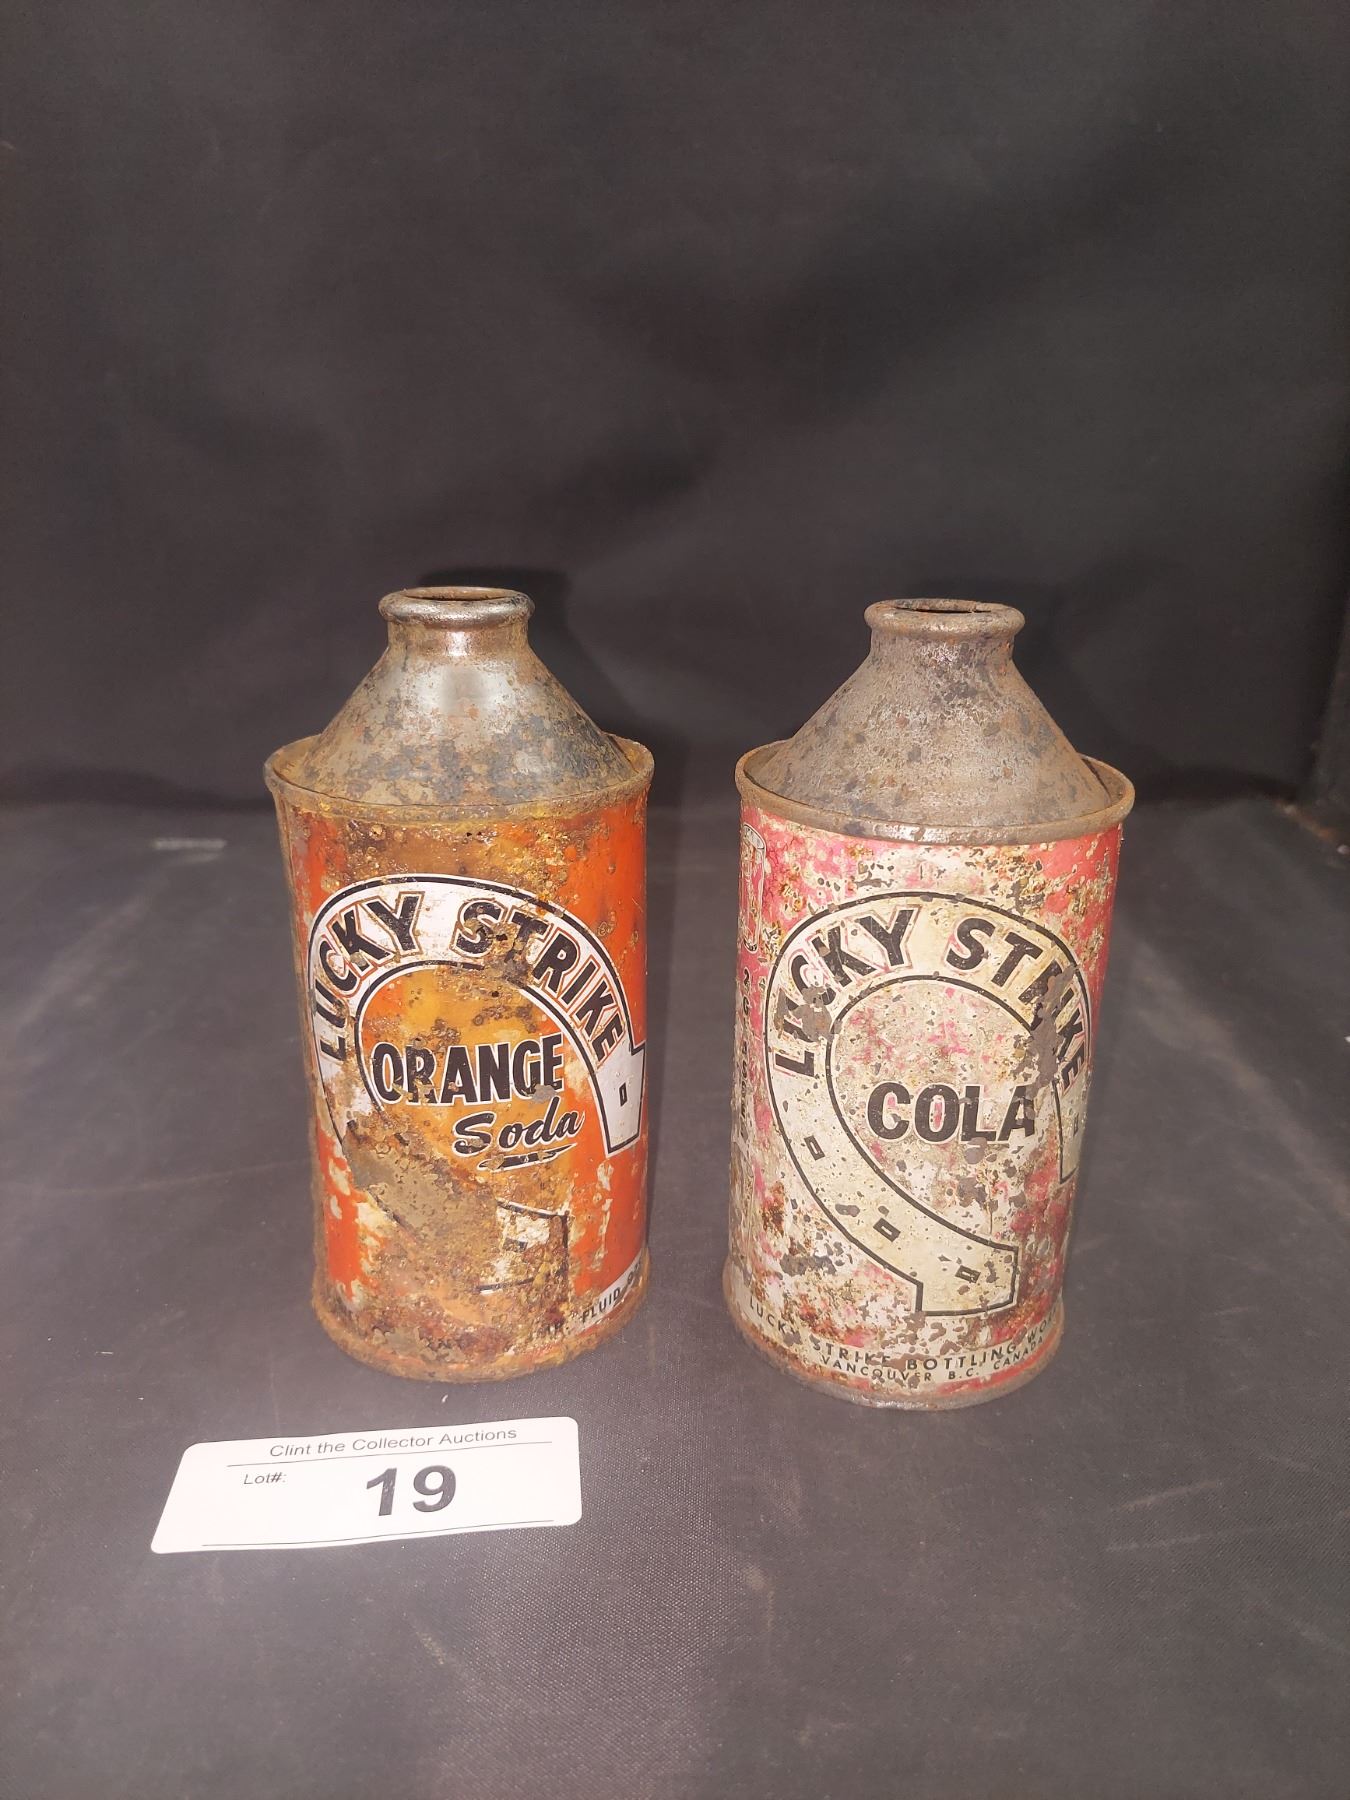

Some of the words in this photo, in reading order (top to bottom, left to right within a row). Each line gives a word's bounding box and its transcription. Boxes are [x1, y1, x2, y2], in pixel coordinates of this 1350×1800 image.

[315, 895, 420, 1062] LUCKY
[456, 900, 624, 1063] STRIKE
[372, 1034, 564, 1104] ORANGE
[453, 1096, 584, 1155] Soda
[867, 1081, 1036, 1142] COLA
[809, 1334, 891, 1367] STRIKE
[906, 1342, 1017, 1371] BOTTLING
[948, 1367, 980, 1380] B.C.
[993, 1335, 1044, 1370] CANADA
[269, 1444, 312, 1457] Clint
[316, 1442, 346, 1454] the
[351, 1435, 435, 1450] Collector
[438, 1427, 518, 1446] Auctions
[243, 1471, 287, 1485] Lot#:
[365, 1464, 457, 1518] 19
